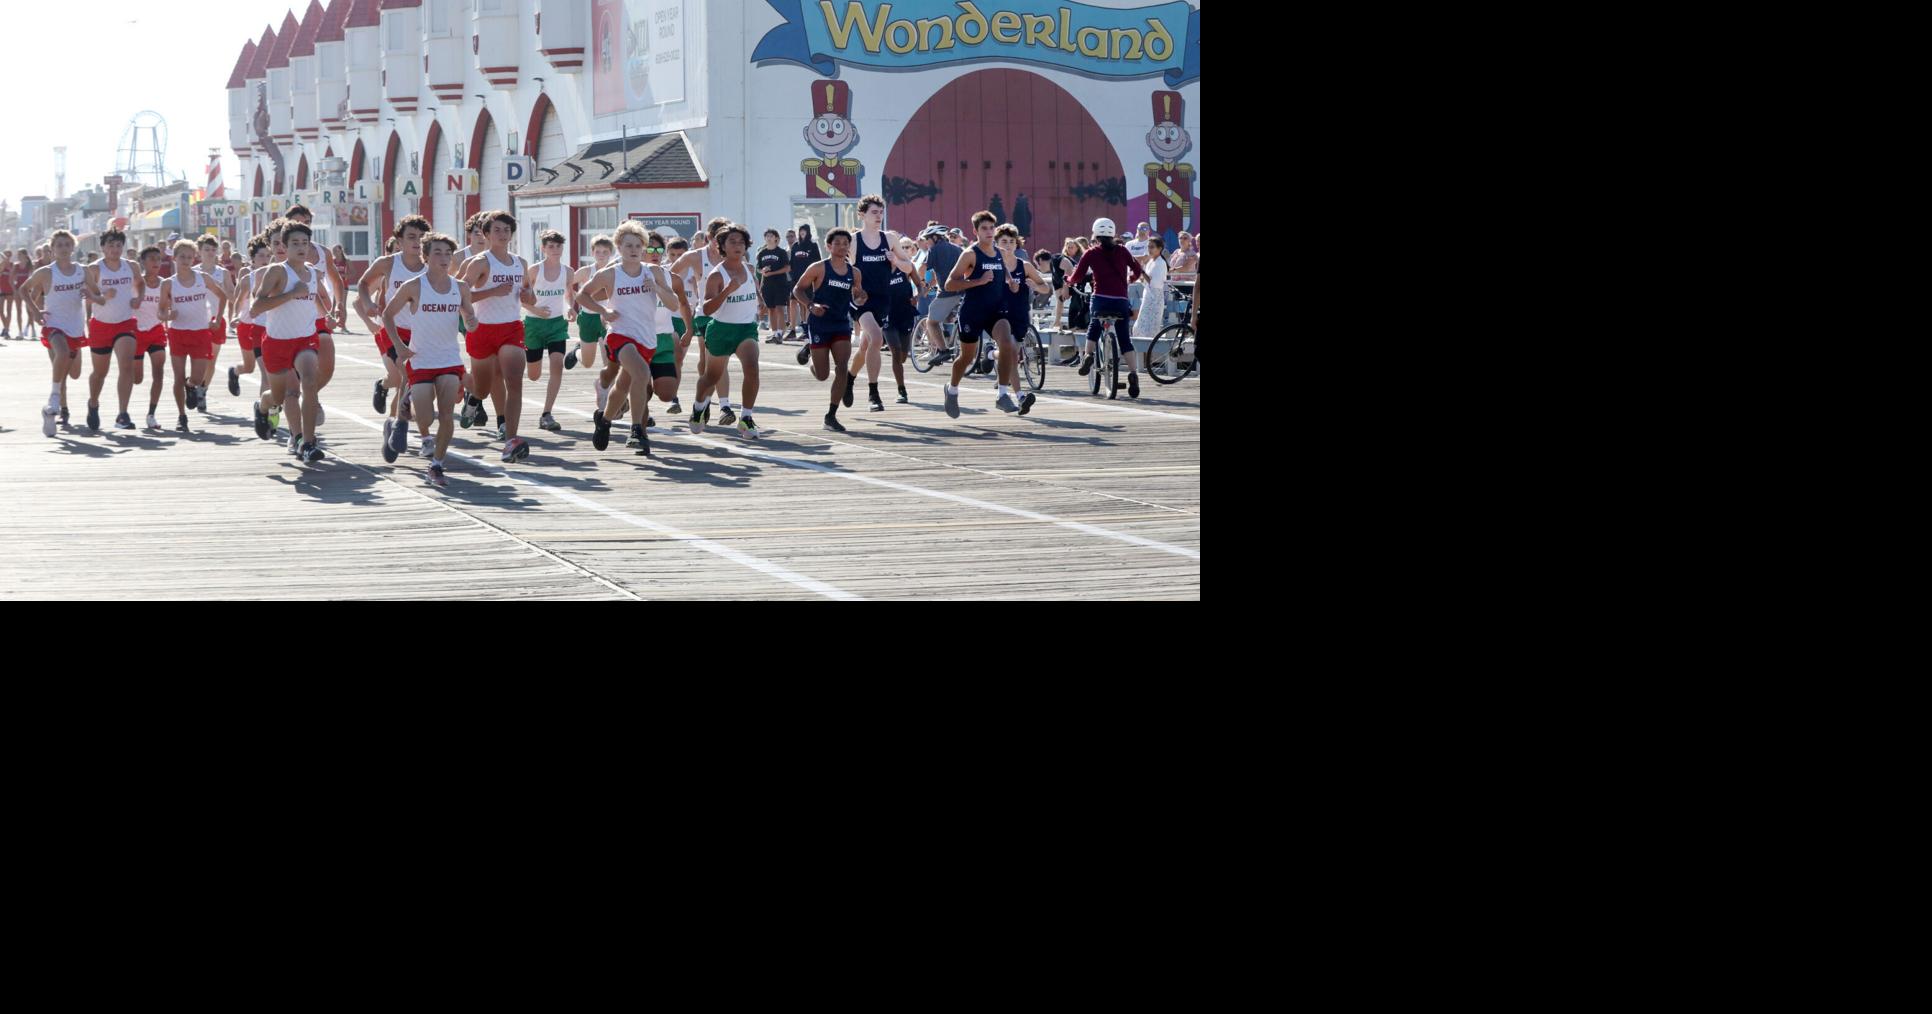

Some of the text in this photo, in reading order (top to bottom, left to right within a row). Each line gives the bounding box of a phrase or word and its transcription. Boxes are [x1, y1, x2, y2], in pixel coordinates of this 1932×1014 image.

[819, 0, 1175, 61] Wonderland
[403, 180, 417, 196] A
[447, 174, 463, 192] N
[507, 162, 523, 180] D
[862, 254, 886, 262] HERMITS
[982, 263, 1003, 271] HERMITS
[492, 274, 514, 283] OCEAN
[54, 284, 74, 292] OCEAN
[828, 279, 850, 290] HERMITS
[616, 286, 640, 296] OCEAN
[174, 293, 206, 304] OCEAN CITY
[422, 303, 460, 313] OCEAN CIT
